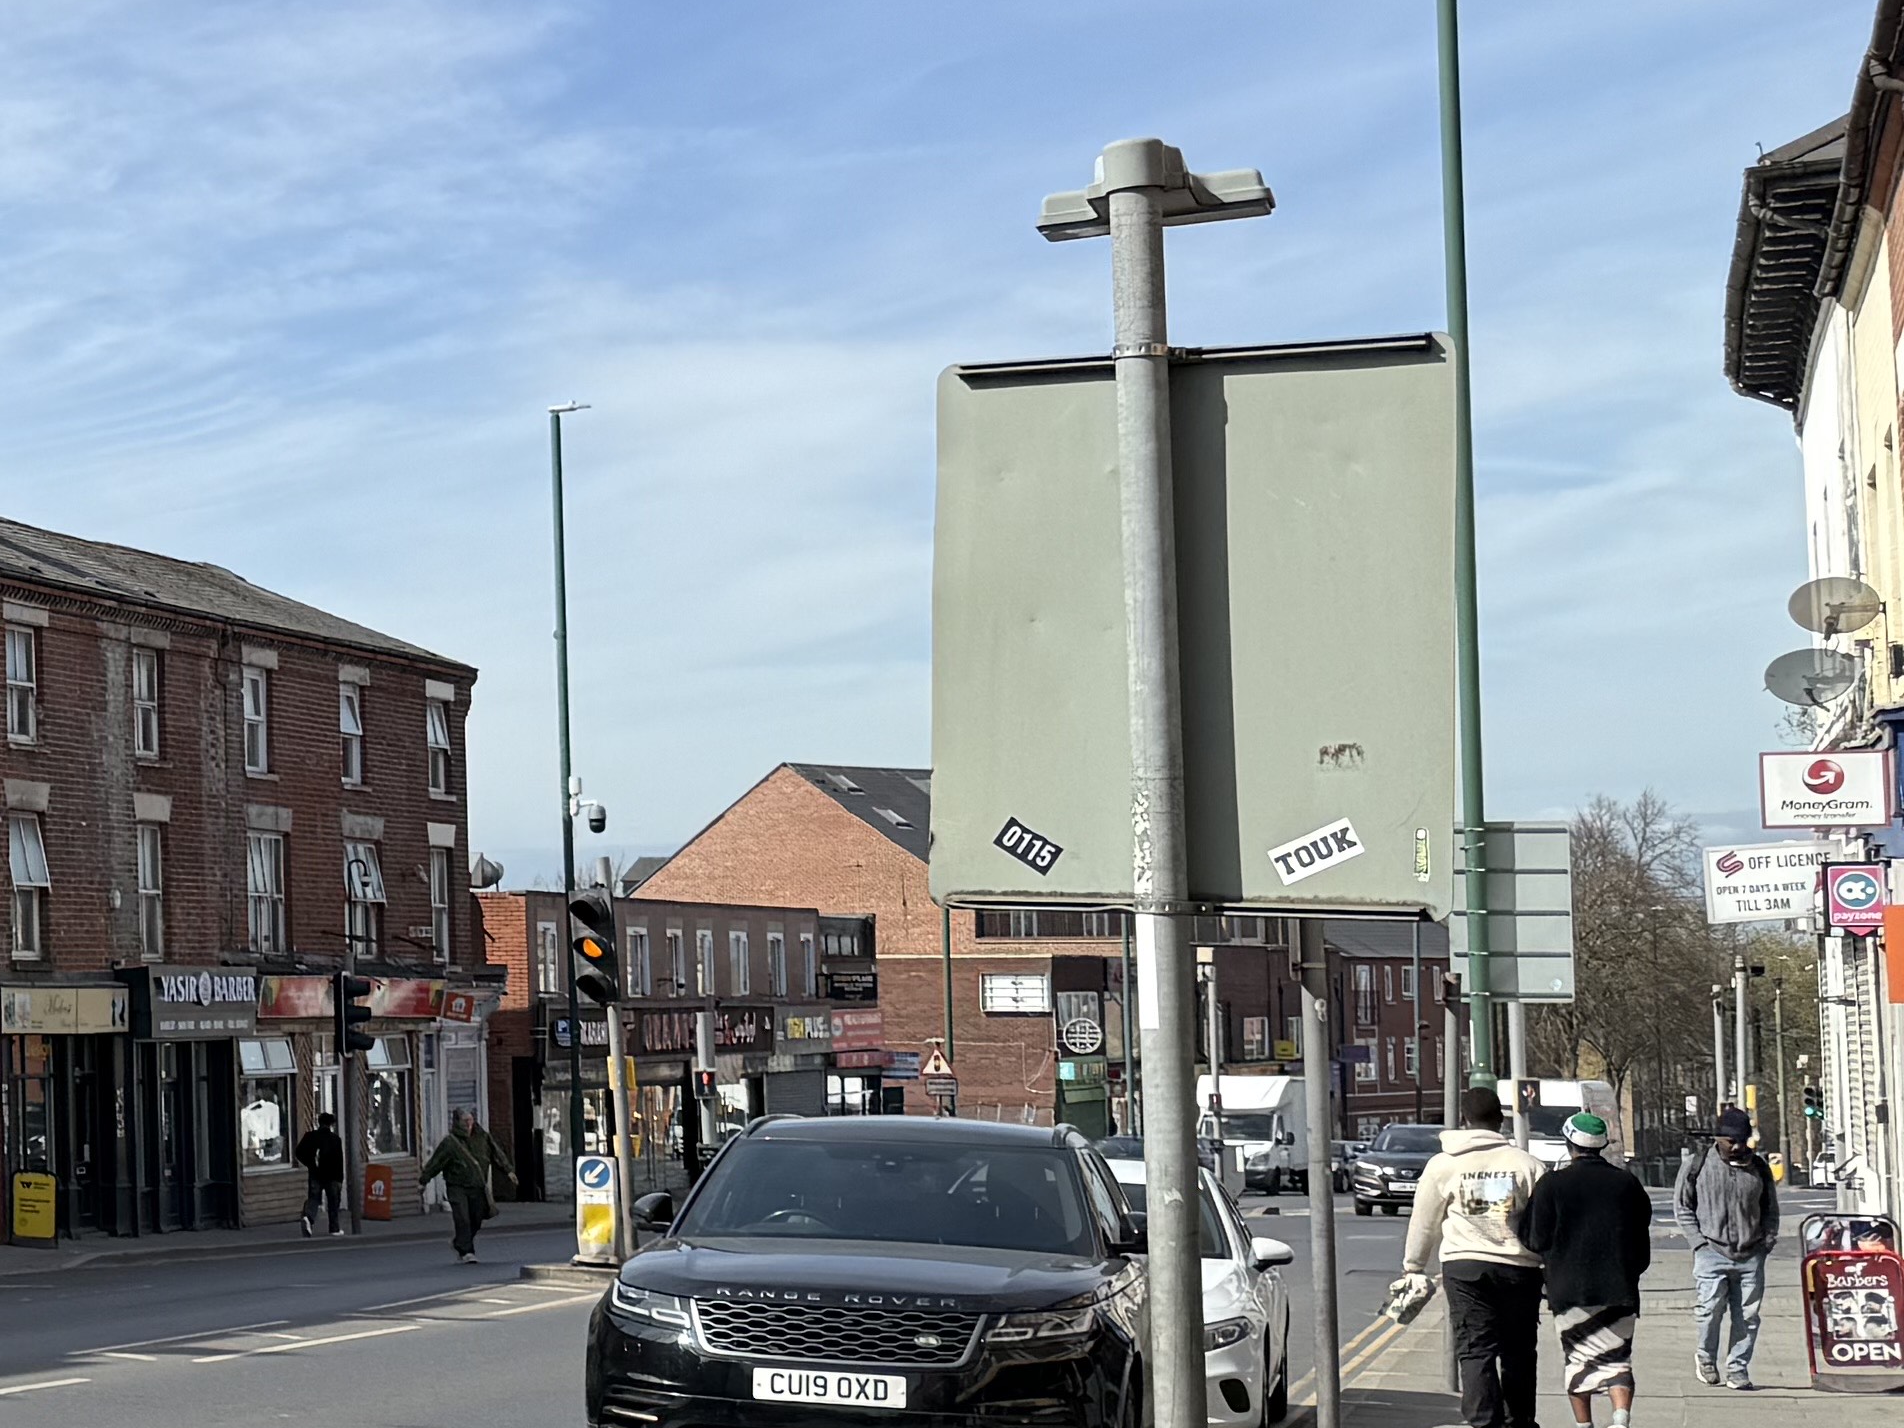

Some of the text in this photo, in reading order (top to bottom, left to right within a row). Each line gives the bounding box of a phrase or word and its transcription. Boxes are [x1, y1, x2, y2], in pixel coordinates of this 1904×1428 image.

[1001, 824, 1057, 868] 0115
[1274, 826, 1358, 876] TOUK
[1748, 852, 1831, 870] OFF LICENCE
[1716, 881, 1807, 895] OPEN 7 DAYS A WEEK
[1736, 898, 1791, 912] TILL 3AM
[1833, 911, 1883, 922] payzone
[161, 976, 256, 1003] YASIR BARBER
[1826, 1273, 1889, 1288] Barbers
[716, 1287, 956, 1307] RANGE ROVER
[1831, 1342, 1902, 1362] OPEN
[770, 1372, 888, 1401] CU19 OXD
